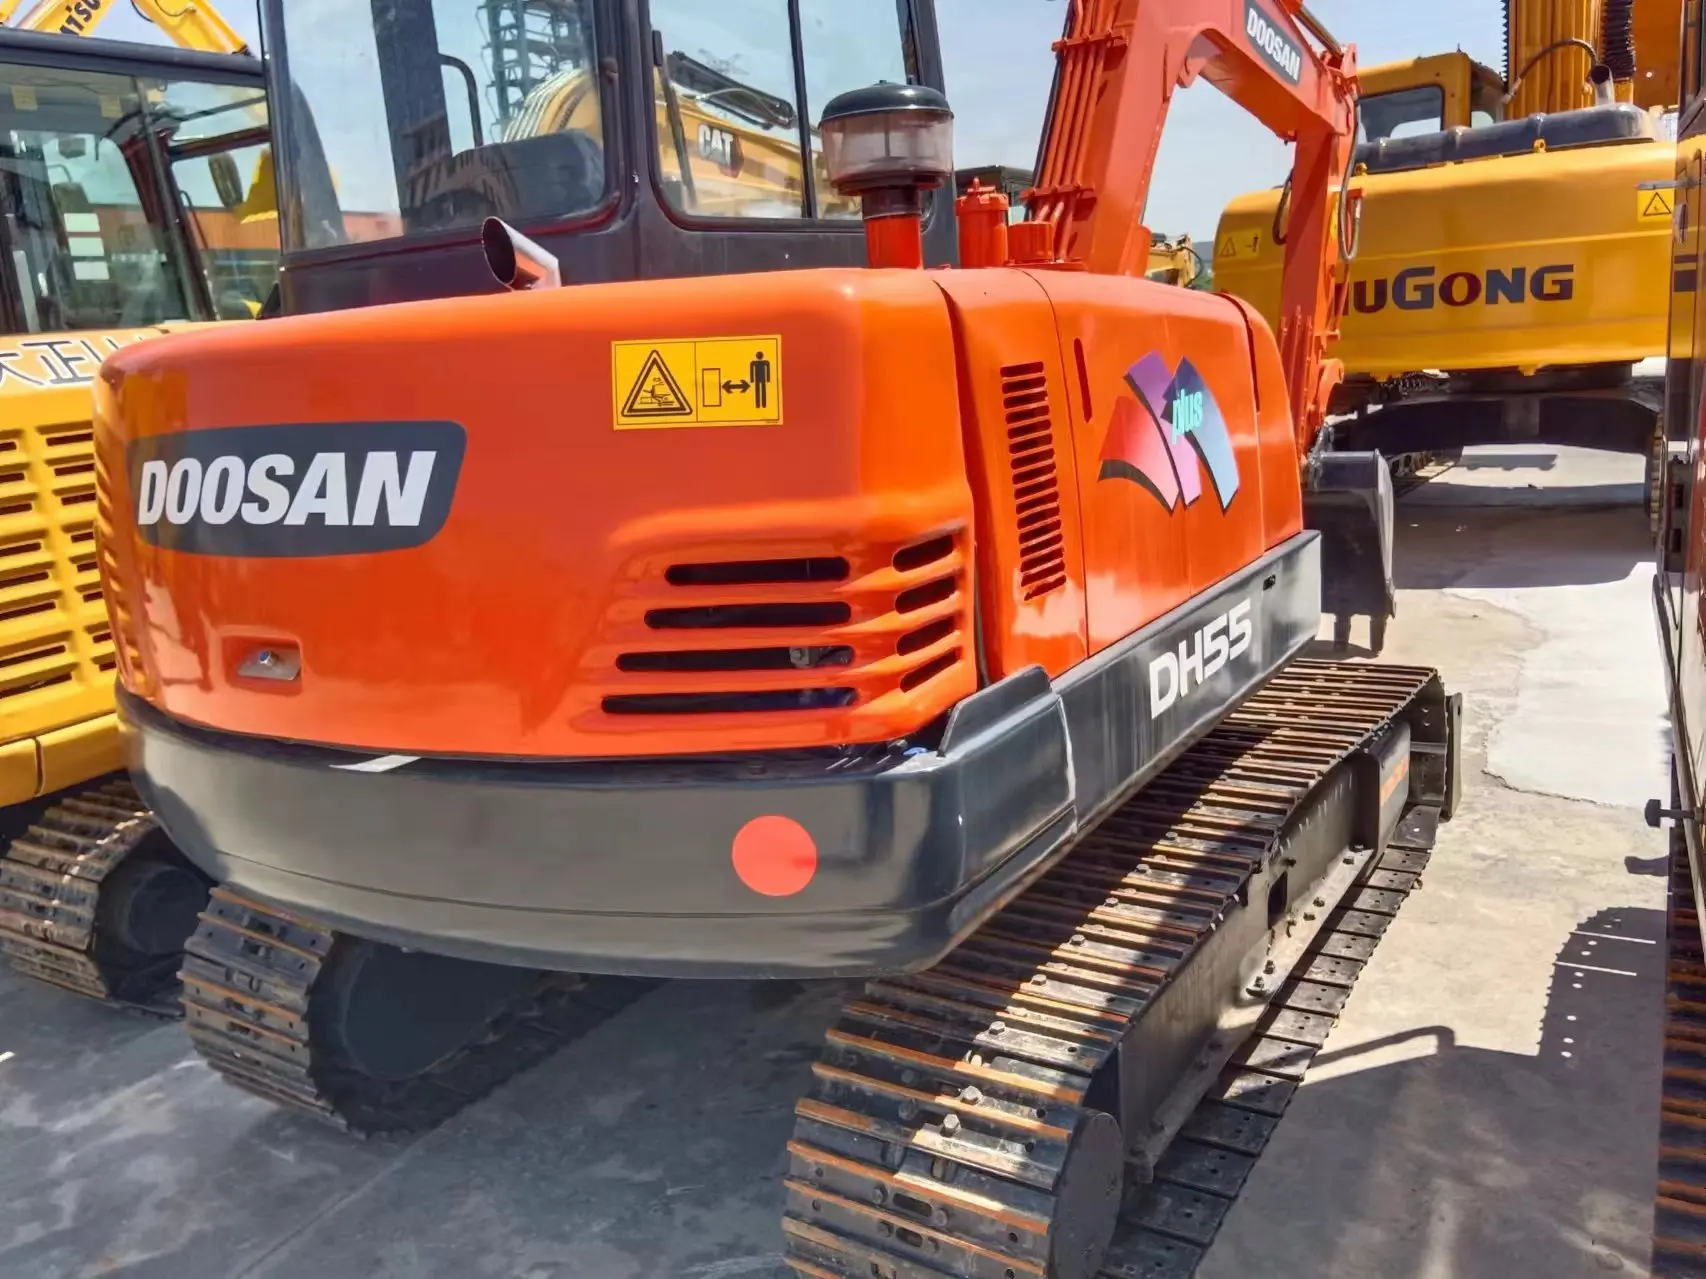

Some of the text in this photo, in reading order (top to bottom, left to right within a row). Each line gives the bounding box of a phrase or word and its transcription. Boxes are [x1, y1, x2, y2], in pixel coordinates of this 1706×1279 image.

[1246, 7, 1301, 82] DOOSAN
[698, 123, 734, 168] CAT
[1171, 388, 1203, 445] plus
[138, 450, 438, 526] DOOSAN
[1149, 597, 1252, 720] DH55
